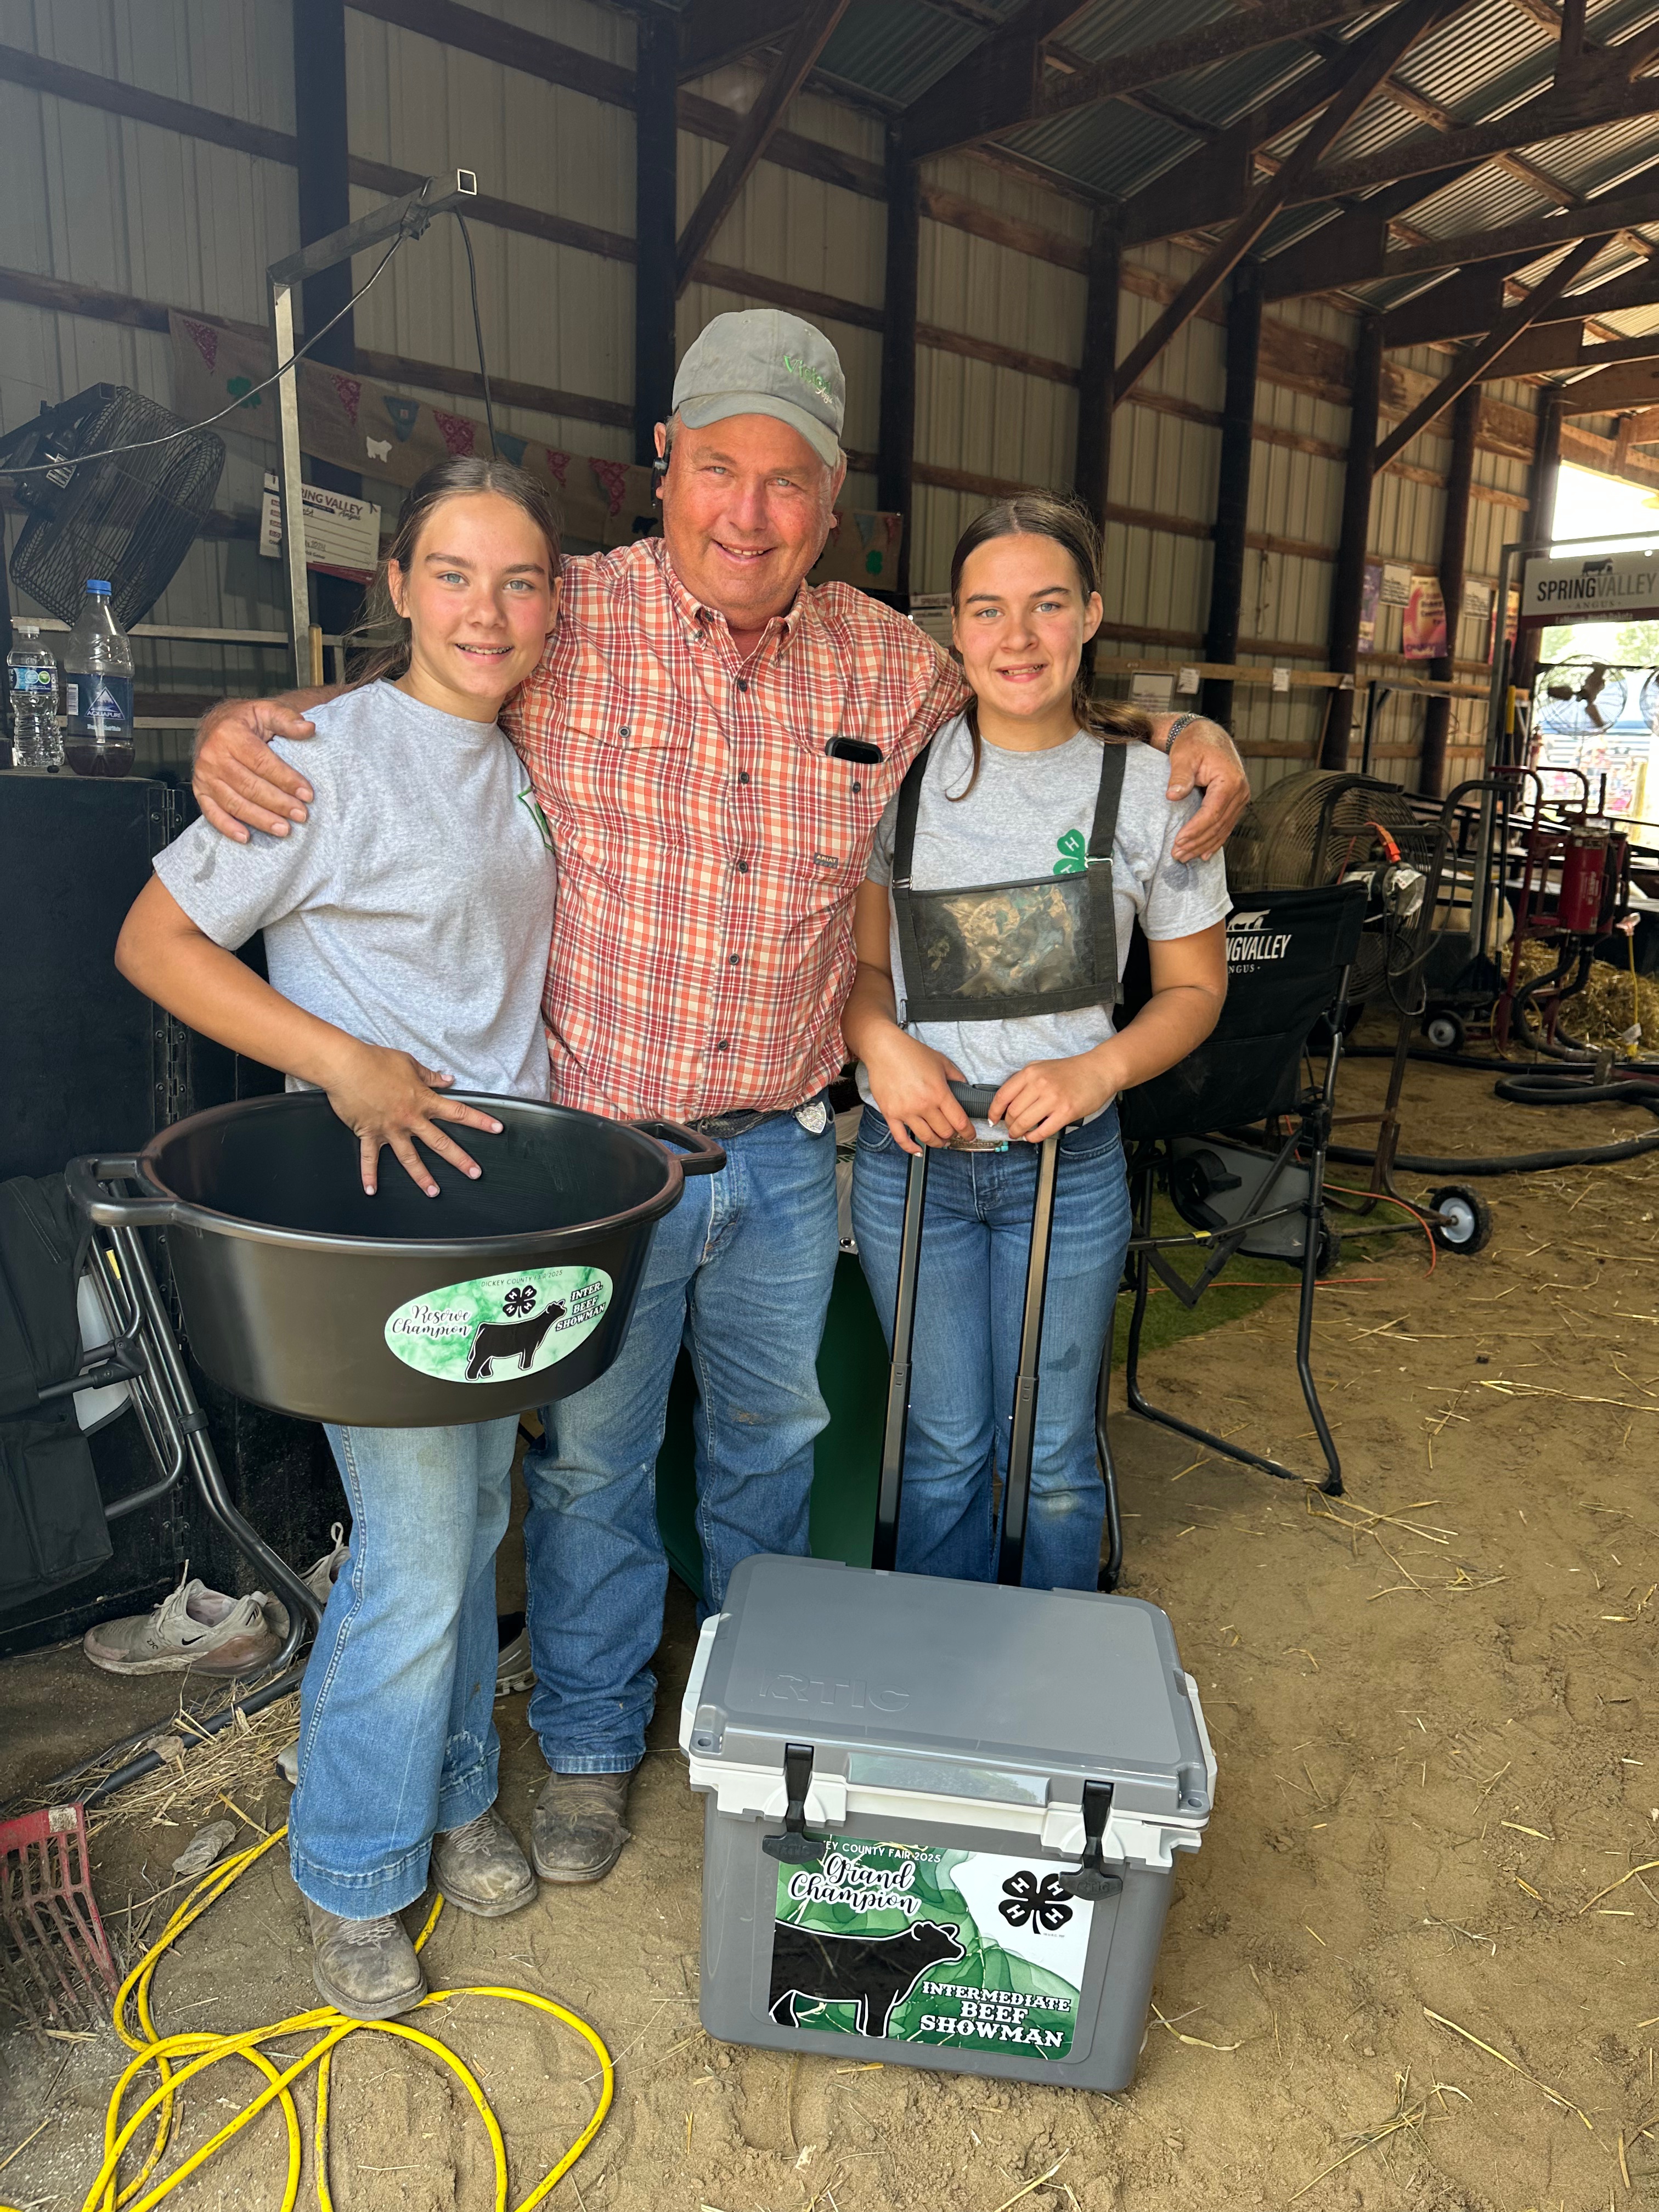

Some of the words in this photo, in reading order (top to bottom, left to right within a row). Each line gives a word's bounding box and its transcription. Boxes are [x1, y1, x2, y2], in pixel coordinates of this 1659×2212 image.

[325, 495, 363, 515] VALLEY
[1537, 572, 1658, 602] SPRINGVALLEY
[1574, 600, 1615, 610] ANGUS
[816, 855, 837, 864] ARIAT
[1228, 964, 1255, 974] NGUS
[506, 1276, 532, 1284] COUNTY
[549, 1269, 563, 1279] 2025
[571, 1281, 603, 1302] INTER.
[412, 1305, 471, 1324] Reserve
[572, 1295, 599, 1315] BEEF
[556, 1302, 606, 1331] SHOWMAN
[392, 1318, 470, 1338] Champion
[759, 1669, 910, 1712] RTIC
[842, 1842, 885, 1857] COUNTY
[889, 1849, 911, 1860] FAIR
[914, 1853, 941, 1863] 2025
[827, 1855, 913, 1889] Grand
[791, 1874, 919, 1914] Champion
[923, 1980, 1071, 2012] INTERMEDIATE
[961, 2000, 1029, 2024] BEEF
[921, 2015, 1064, 2047] SHOWMAN
